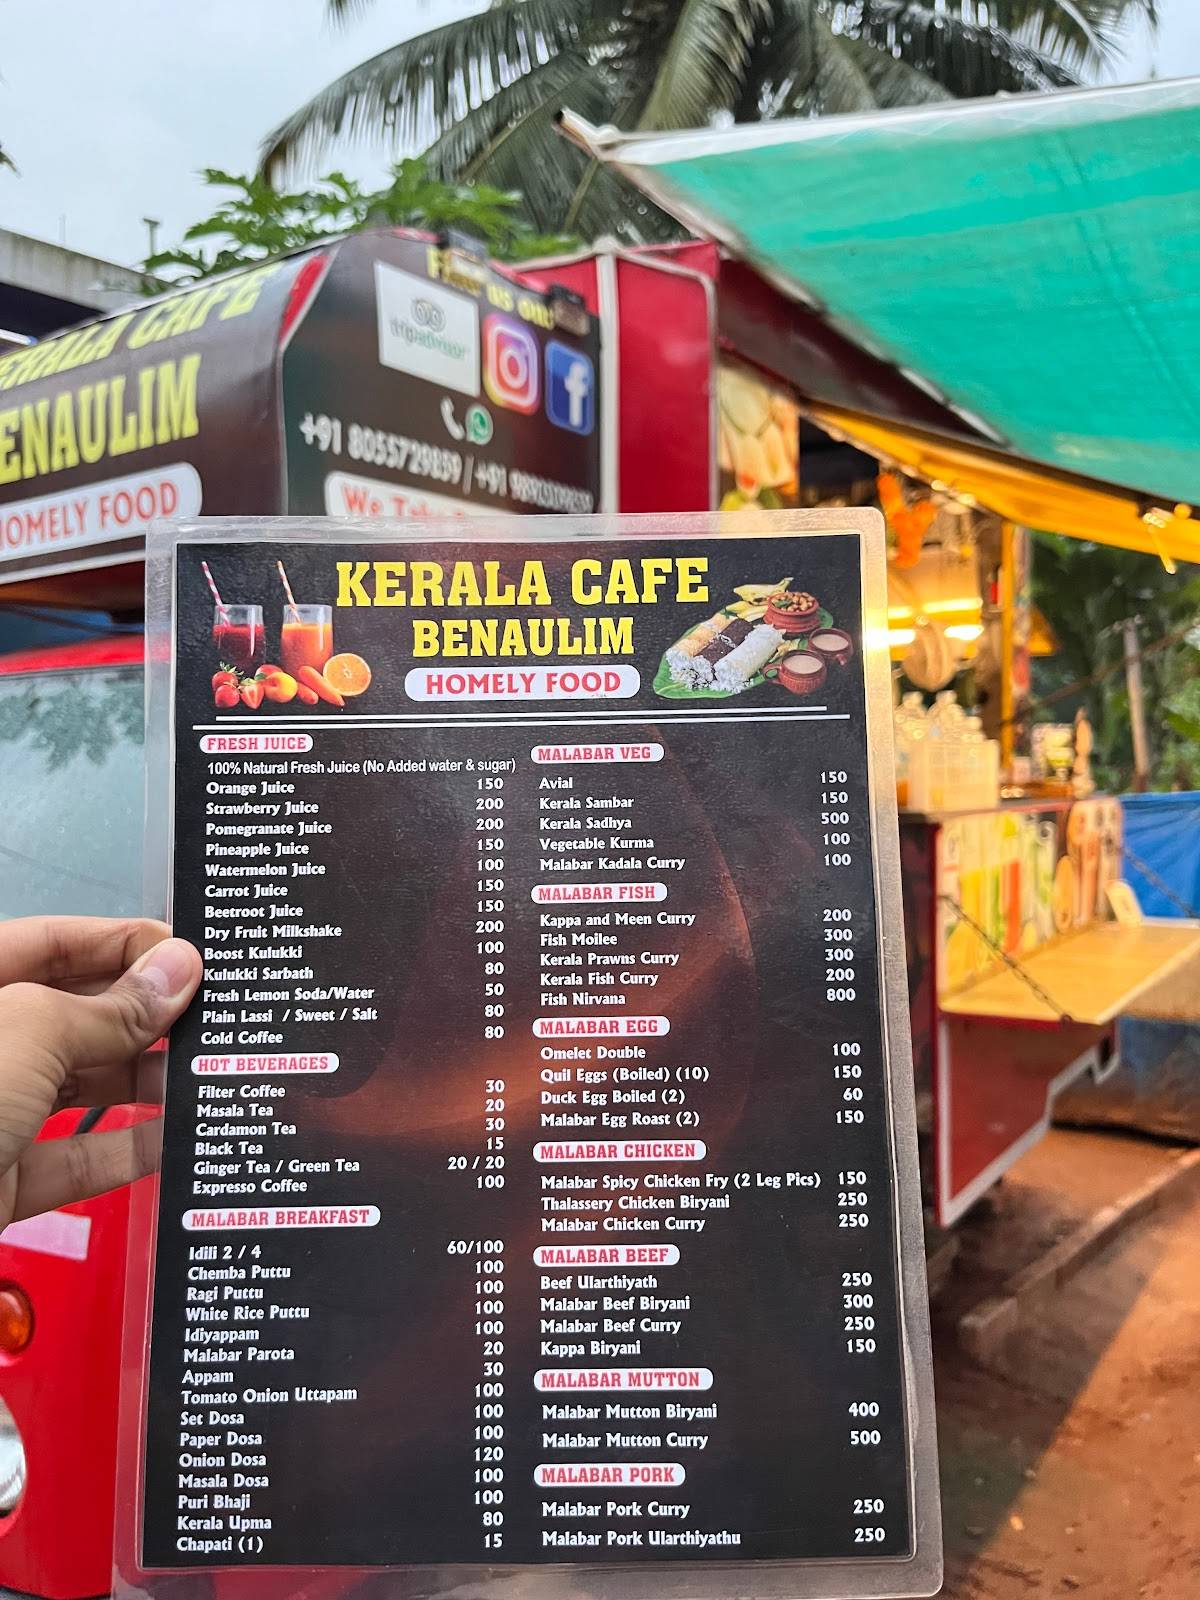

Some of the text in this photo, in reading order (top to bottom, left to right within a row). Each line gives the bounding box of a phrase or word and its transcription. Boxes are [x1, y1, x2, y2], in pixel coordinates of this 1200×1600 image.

[300, 412, 342, 455] +91
[0, 482, 178, 548] OMELY FOOD
[336, 557, 710, 607] KERALA CAFE
[412, 617, 635, 657] BENAULIM
[425, 672, 621, 694] HOMELY FOOD
[207, 737, 305, 750] FRESH JUICE
[538, 746, 650, 760] MALABAR VEG
[207, 758, 515, 775] 100% Natural Fresh Juice (No Added water & sugar)
[477, 777, 503, 789] 150
[539, 776, 572, 789] Avial
[821, 771, 847, 783] 150
[206, 780, 294, 796] Orange Juice
[540, 796, 634, 809] Kerala Sambar
[821, 791, 848, 803] 150
[206, 821, 332, 837] Pomegranate Juice
[475, 818, 503, 830] 200
[539, 836, 654, 852] Vegetable Kurma
[823, 832, 850, 845] 100
[205, 861, 325, 877] Watermelon Juice
[477, 858, 504, 871] 100
[538, 885, 655, 900] MALABAR FISH
[205, 904, 303, 919] Beetroot Juice
[477, 899, 504, 912] 150
[540, 912, 695, 928] Kappa and Meen Curry
[823, 908, 851, 921] 200
[205, 924, 342, 941] Dry Fruit Milkshake
[475, 920, 504, 933] 200
[204, 944, 302, 960] Boost Kulukki
[477, 941, 504, 953] 100
[825, 948, 853, 961] 300
[540, 951, 679, 966] Kerala Prawns Curry
[204, 986, 374, 1002] Fresh Lemon Soda/Water
[485, 982, 504, 996] 50
[827, 988, 855, 1001] 800
[541, 992, 625, 1005] Fish Nirvana
[485, 1025, 504, 1038] 80
[540, 1019, 657, 1034] MALABAR EGG
[201, 1030, 283, 1044] Cold Coffee
[540, 1046, 645, 1059] Omelet Double
[833, 1042, 860, 1056] 100
[198, 1056, 328, 1071] HOT BEVERAGES
[541, 1089, 685, 1105] Duck Egg Boiled (2)
[843, 1087, 863, 1101] 60
[195, 1121, 296, 1136] Cardamon Tea
[485, 1117, 504, 1130] 30
[541, 1143, 695, 1159] MALABAR CHICKEN
[477, 1174, 504, 1188] 100
[541, 1175, 597, 1189] Malabar
[602, 1174, 639, 1190] Spicy
[644, 1173, 700, 1187] Chicken
[706, 1173, 728, 1189] Fry
[756, 1172, 781, 1188] Leg
[786, 1172, 820, 1188] Pics)
[838, 1171, 866, 1184] 150
[193, 1178, 307, 1196] Expresso Coffee
[541, 1194, 729, 1212] Thalassery Chicken Biryani
[838, 1192, 867, 1206] 250
[192, 1209, 369, 1226] MALABAR BREAKFAST
[541, 1248, 668, 1263] MALABAR BEEF
[188, 1264, 290, 1280] Chemba Puttu
[476, 1260, 503, 1273] 100
[541, 1274, 657, 1290] Beef Ularthiyath
[842, 1272, 872, 1286] 250
[185, 1304, 309, 1321] White Rice Puttu
[475, 1300, 503, 1314] 100
[540, 1318, 681, 1334] Malabar Beef Curry
[844, 1316, 874, 1330] 250
[484, 1362, 503, 1376] 30
[181, 1369, 233, 1386] Appam
[541, 1371, 699, 1387] MALABAR MUTTON
[542, 1403, 716, 1420] Malabar Mutton Biryani
[848, 1402, 879, 1416] 400
[475, 1424, 503, 1439] 100
[180, 1431, 262, 1448] Paper Dosa
[178, 1473, 268, 1488] Masala Dosa
[475, 1468, 503, 1482] 100
[542, 1467, 674, 1483] MALABAR PORK
[177, 1515, 271, 1532] Kerala Upma
[483, 1511, 503, 1526] 80
[484, 1533, 502, 1548] 15
[542, 1530, 740, 1547] Malabar Pork Ularthiyathu
[854, 1527, 885, 1542] 250
[176, 1536, 263, 1553] Chapati (1)
